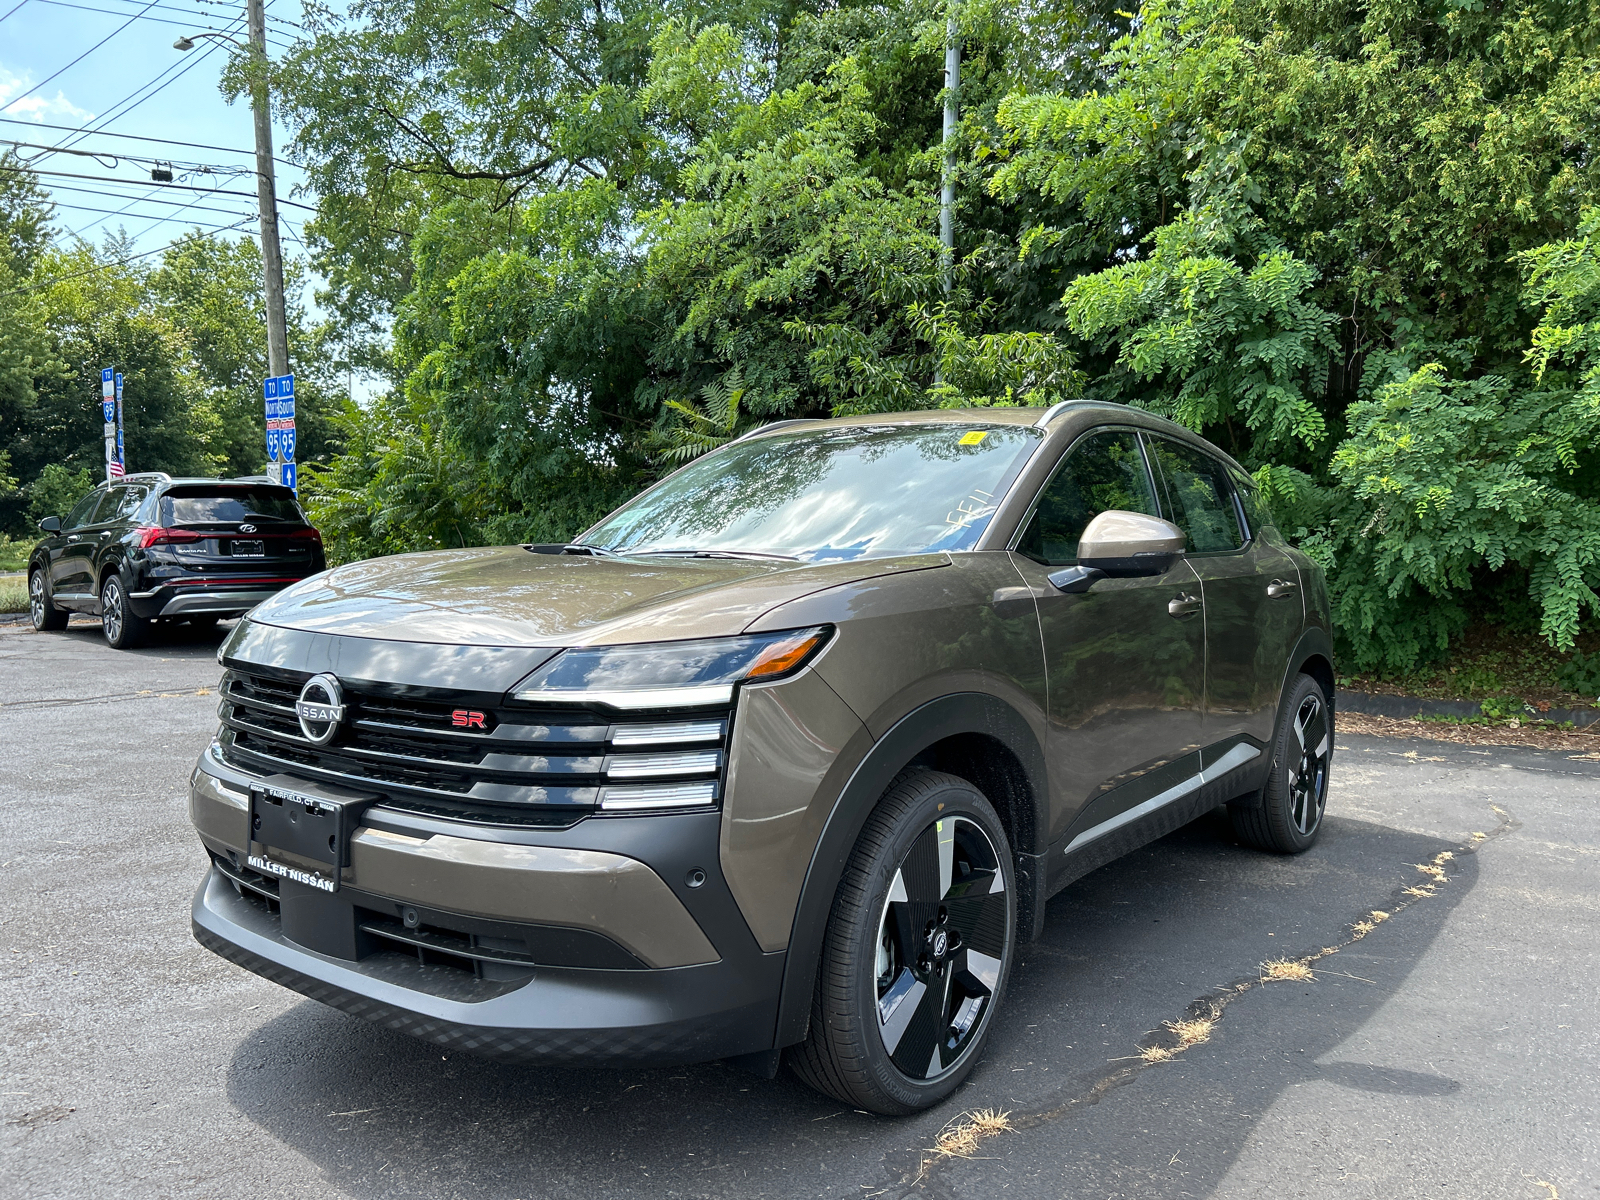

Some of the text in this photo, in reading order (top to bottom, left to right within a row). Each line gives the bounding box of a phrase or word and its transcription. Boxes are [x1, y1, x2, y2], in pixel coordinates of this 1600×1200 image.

[268, 382, 276, 394] TO
[282, 380, 290, 392] TO
[106, 404, 112, 417] 95
[266, 402, 278, 415] NORTH
[279, 401, 294, 414] SOUTH
[269, 434, 278, 453] 95
[282, 433, 294, 453] 95
[296, 704, 340, 720] NISSAN
[452, 710, 486, 728] SR
[304, 798, 314, 806] CT
[248, 856, 334, 892] MILLER NISSAN
